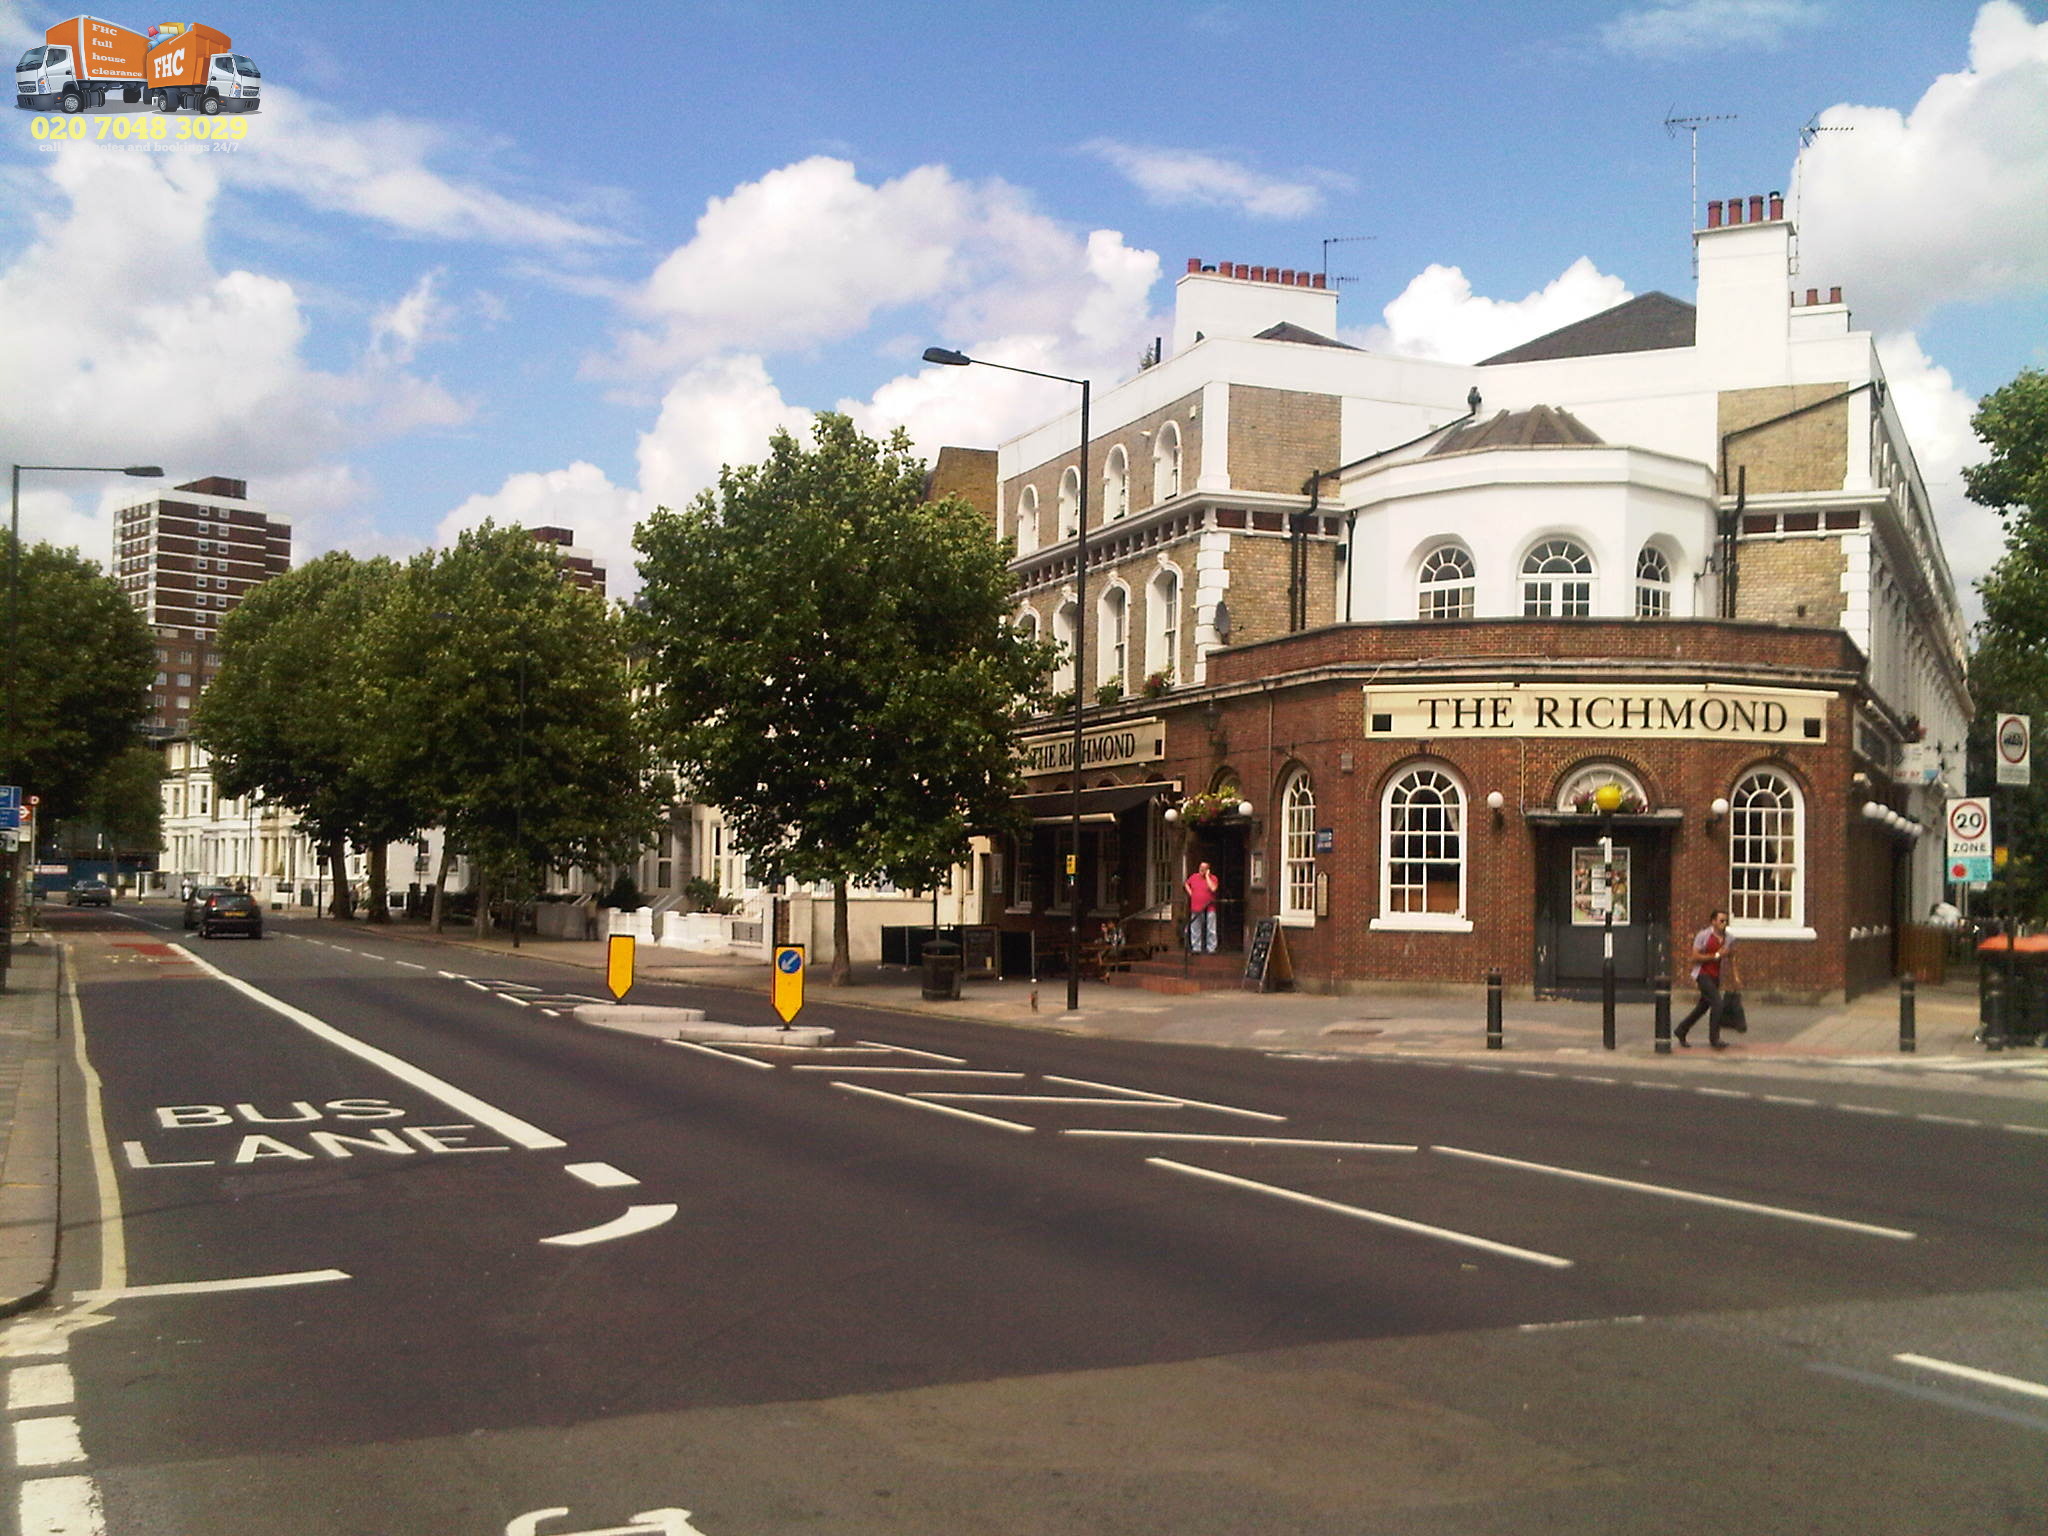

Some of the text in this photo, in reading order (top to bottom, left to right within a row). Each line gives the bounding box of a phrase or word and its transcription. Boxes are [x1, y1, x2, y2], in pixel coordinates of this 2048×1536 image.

[1417, 696, 1788, 733] THE RICHMOND
[1032, 733, 1136, 770] THE RIHMOND
[1956, 812, 1982, 829] 20
[1953, 842, 1987, 853] ZONE
[156, 1098, 406, 1128] BUS
[122, 1125, 511, 1169] LANE
